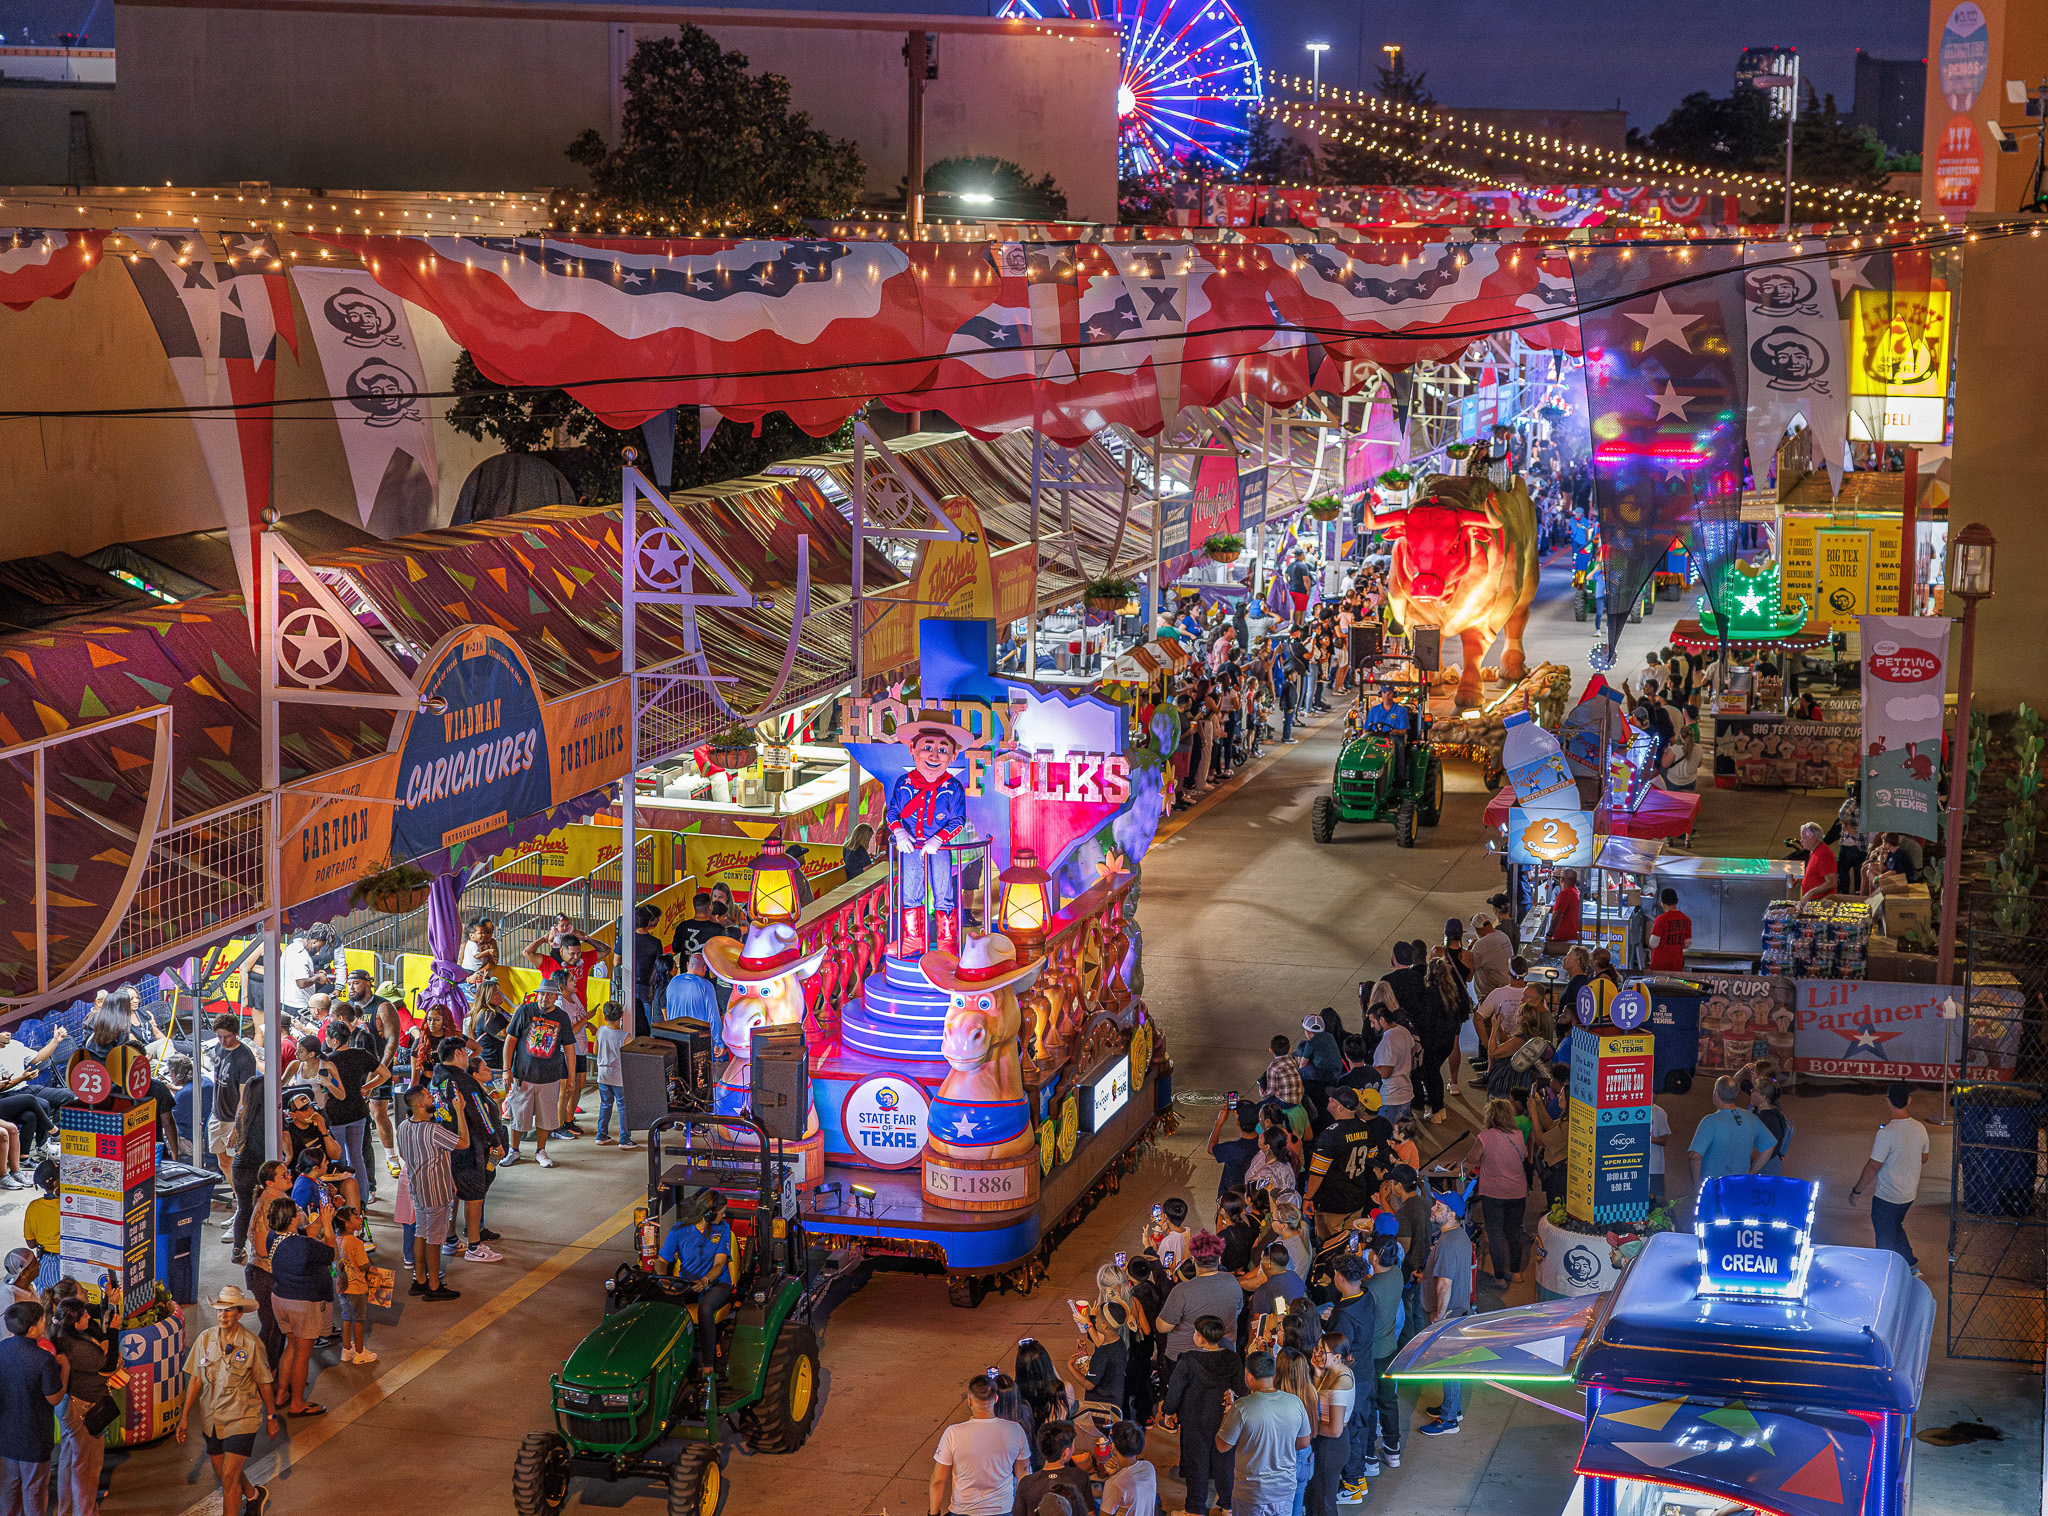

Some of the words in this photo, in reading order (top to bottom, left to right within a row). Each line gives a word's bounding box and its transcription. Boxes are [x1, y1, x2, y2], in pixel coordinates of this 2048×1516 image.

[1883, 413, 1911, 426] DELI
[1826, 549, 1841, 562] BIG
[1842, 549, 1859, 562] TEX
[1829, 564, 1858, 578] STORE
[1876, 657, 1936, 670] PETTING
[1890, 667, 1923, 678] ZOO
[444, 698, 501, 743] WILDMAN
[1752, 723, 1769, 735] BIG
[1772, 724, 1790, 735] TEX
[1793, 725, 1842, 738] SOUVENIR
[560, 724, 624, 774] PORTRAITS
[406, 728, 537, 810] CARICATURES
[964, 750, 1131, 804] FOLKS
[1512, 762, 1550, 790] Pardner's
[1523, 788, 1549, 802] BOTTLED
[1549, 780, 1570, 793] WATER
[1894, 787, 1914, 797] STATE
[1894, 798, 1928, 813] TEXAS
[302, 808, 368, 863] CARTOON
[445, 825, 482, 845] INTRODUCED
[483, 821, 490, 831] IN
[1543, 821, 1559, 844] 2
[1527, 841, 1575, 856] Coupons
[315, 856, 358, 883] PORTRAITS
[550, 859, 565, 867] DOGS
[685, 928, 702, 950] 3
[1733, 980, 1770, 997] CUPS
[1807, 984, 1858, 1008] Lil'
[1581, 997, 1591, 1016] 19
[1619, 1002, 1638, 1020] 19
[1796, 997, 1944, 1031] Pardner's
[1584, 1056, 1594, 1069] LAY
[1809, 1059, 1912, 1076] BOTTLED
[1919, 1065, 2000, 1082] WATER
[78, 1073, 102, 1093] 23
[133, 1067, 147, 1090] 23
[1576, 1073, 1591, 1086] LAND
[1606, 1074, 1632, 1092] PETTING
[136, 1113, 150, 1126] TEXAS
[859, 1112, 890, 1125] STATE
[893, 1114, 917, 1126] FAIR
[101, 1139, 116, 1148] 20
[859, 1131, 917, 1148] TEXAS
[1610, 1136, 1636, 1146] ONCOR
[101, 1148, 116, 1156] 23
[1345, 1145, 1368, 1180] 43
[930, 1170, 1012, 1194] EST.1886
[1631, 1171, 1638, 1179] TO
[1611, 1183, 1622, 1192] 9:00
[1737, 1229, 1763, 1249] ICE
[1721, 1254, 1778, 1274] CREAM
[163, 1406, 179, 1422] BIG
